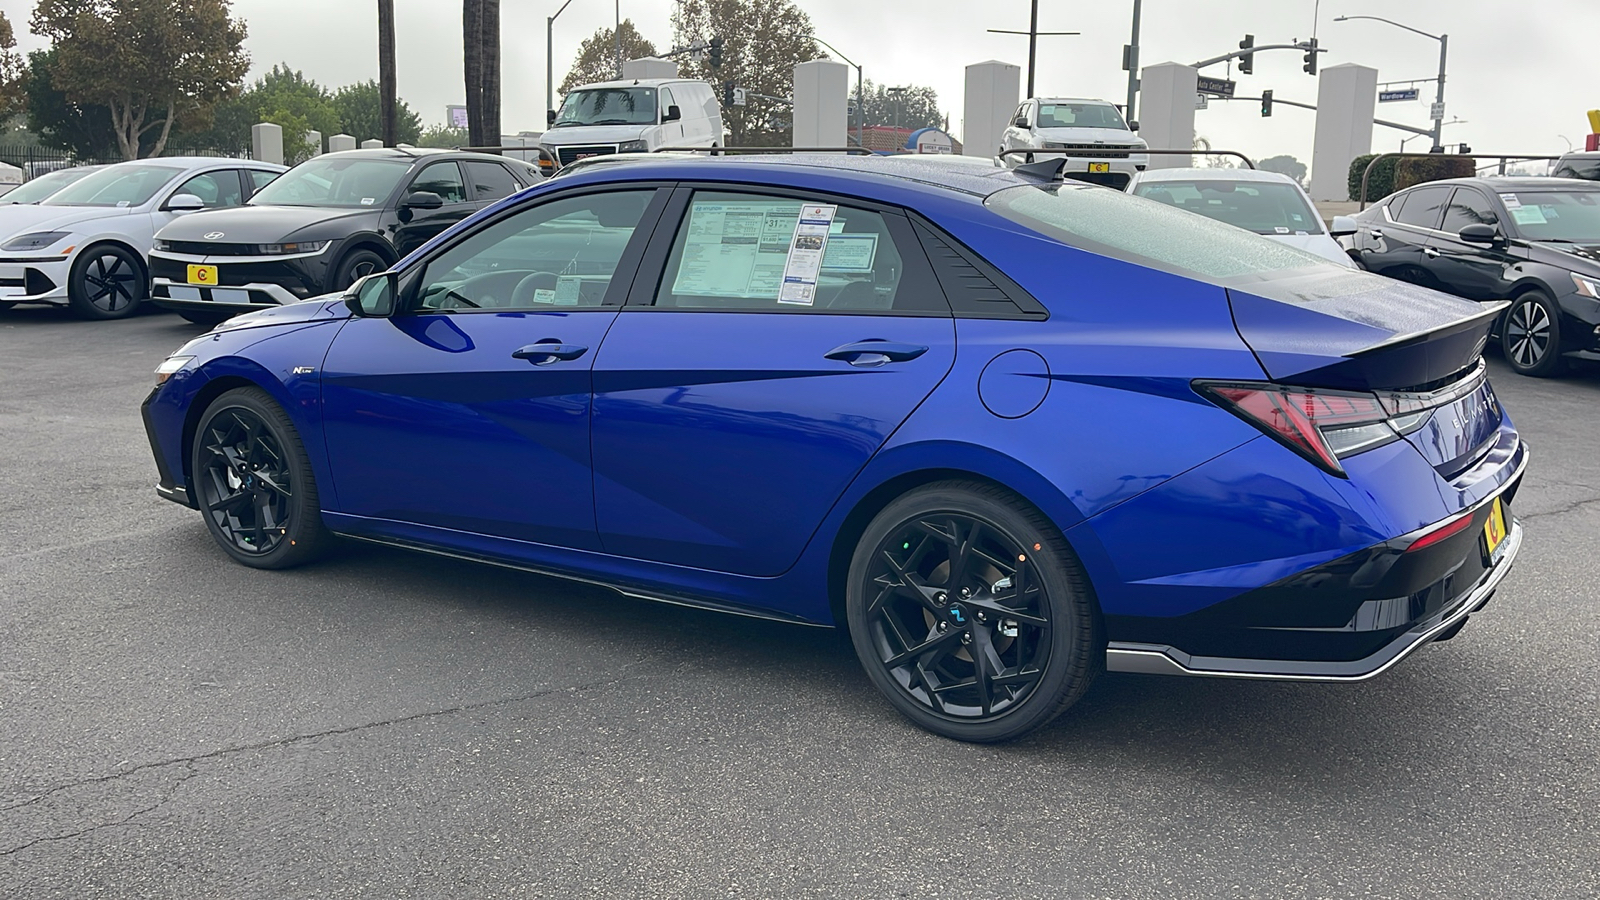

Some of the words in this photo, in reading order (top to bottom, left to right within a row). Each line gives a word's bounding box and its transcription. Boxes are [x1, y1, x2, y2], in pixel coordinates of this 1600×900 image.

[1199, 80, 1208, 89] Auto
[1209, 82, 1223, 91] Center
[769, 219, 777, 228] 31
